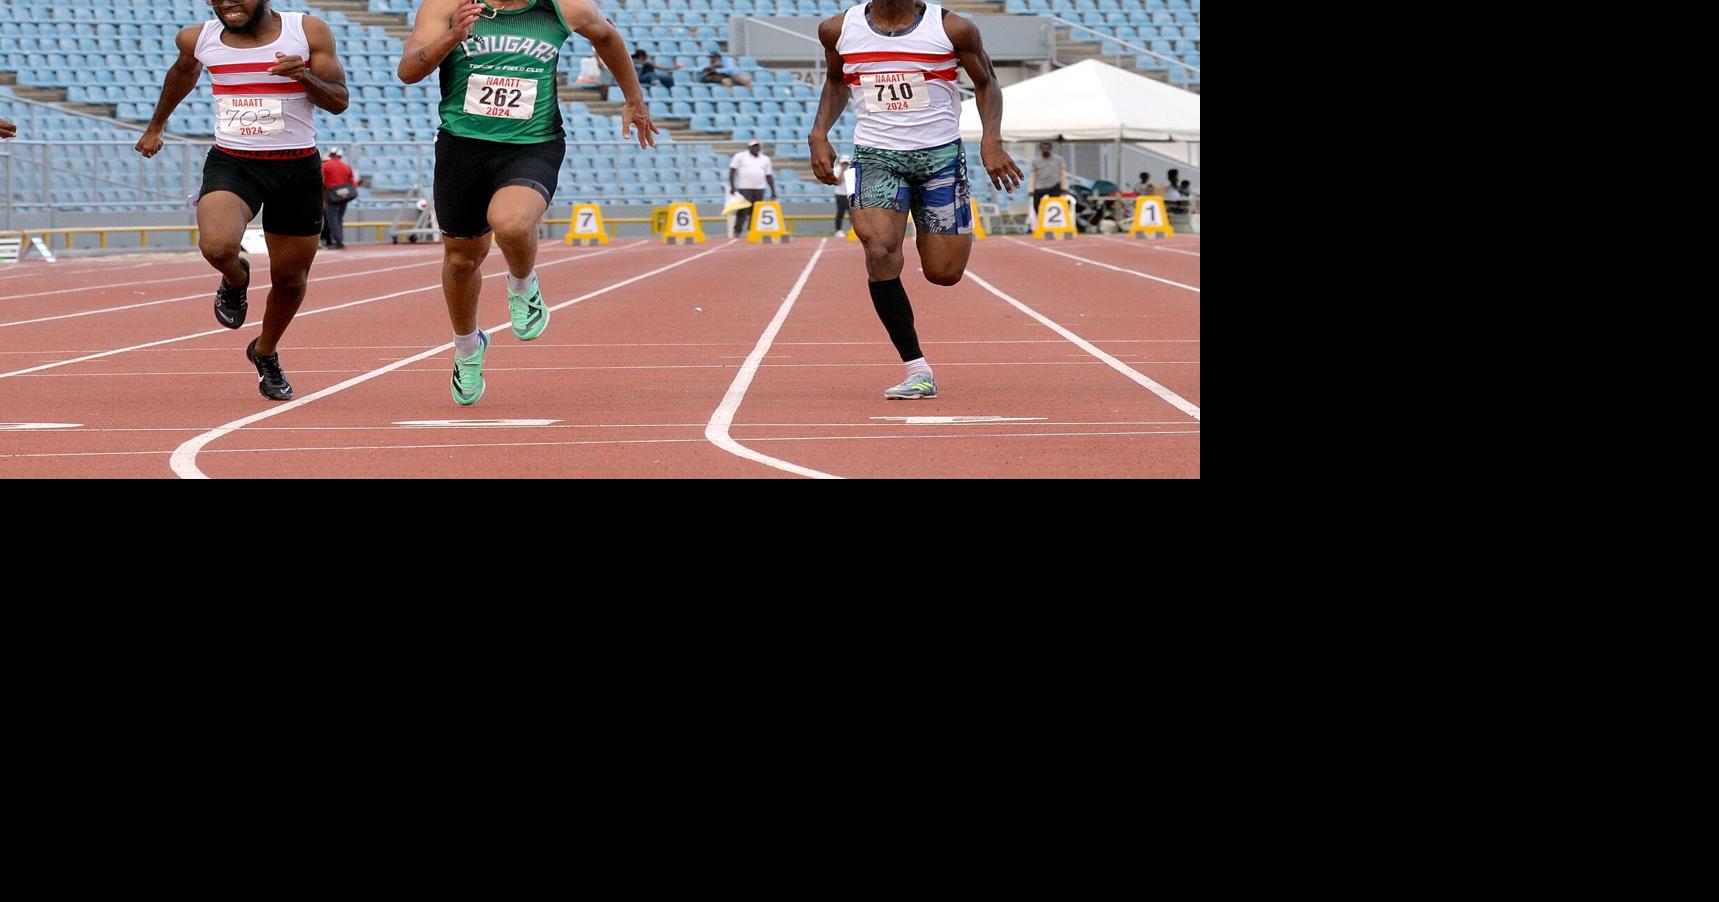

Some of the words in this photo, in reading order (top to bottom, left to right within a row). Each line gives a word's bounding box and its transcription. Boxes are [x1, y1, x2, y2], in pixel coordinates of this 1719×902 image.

[461, 34, 559, 64] COUGARS
[486, 76, 521, 88] NAAATT
[875, 73, 906, 84] NAAATT
[479, 86, 522, 108] 262
[874, 82, 914, 102] 710
[232, 98, 264, 108] NAAATT
[885, 101, 909, 111] 2024
[225, 108, 277, 128] 703
[486, 106, 510, 117] 2024
[240, 126, 264, 136] 2024
[579, 212, 593, 228] 7
[676, 211, 690, 228] 6
[761, 210, 775, 226] 5
[1047, 206, 1063, 223] 2
[1145, 204, 1156, 222] 1
